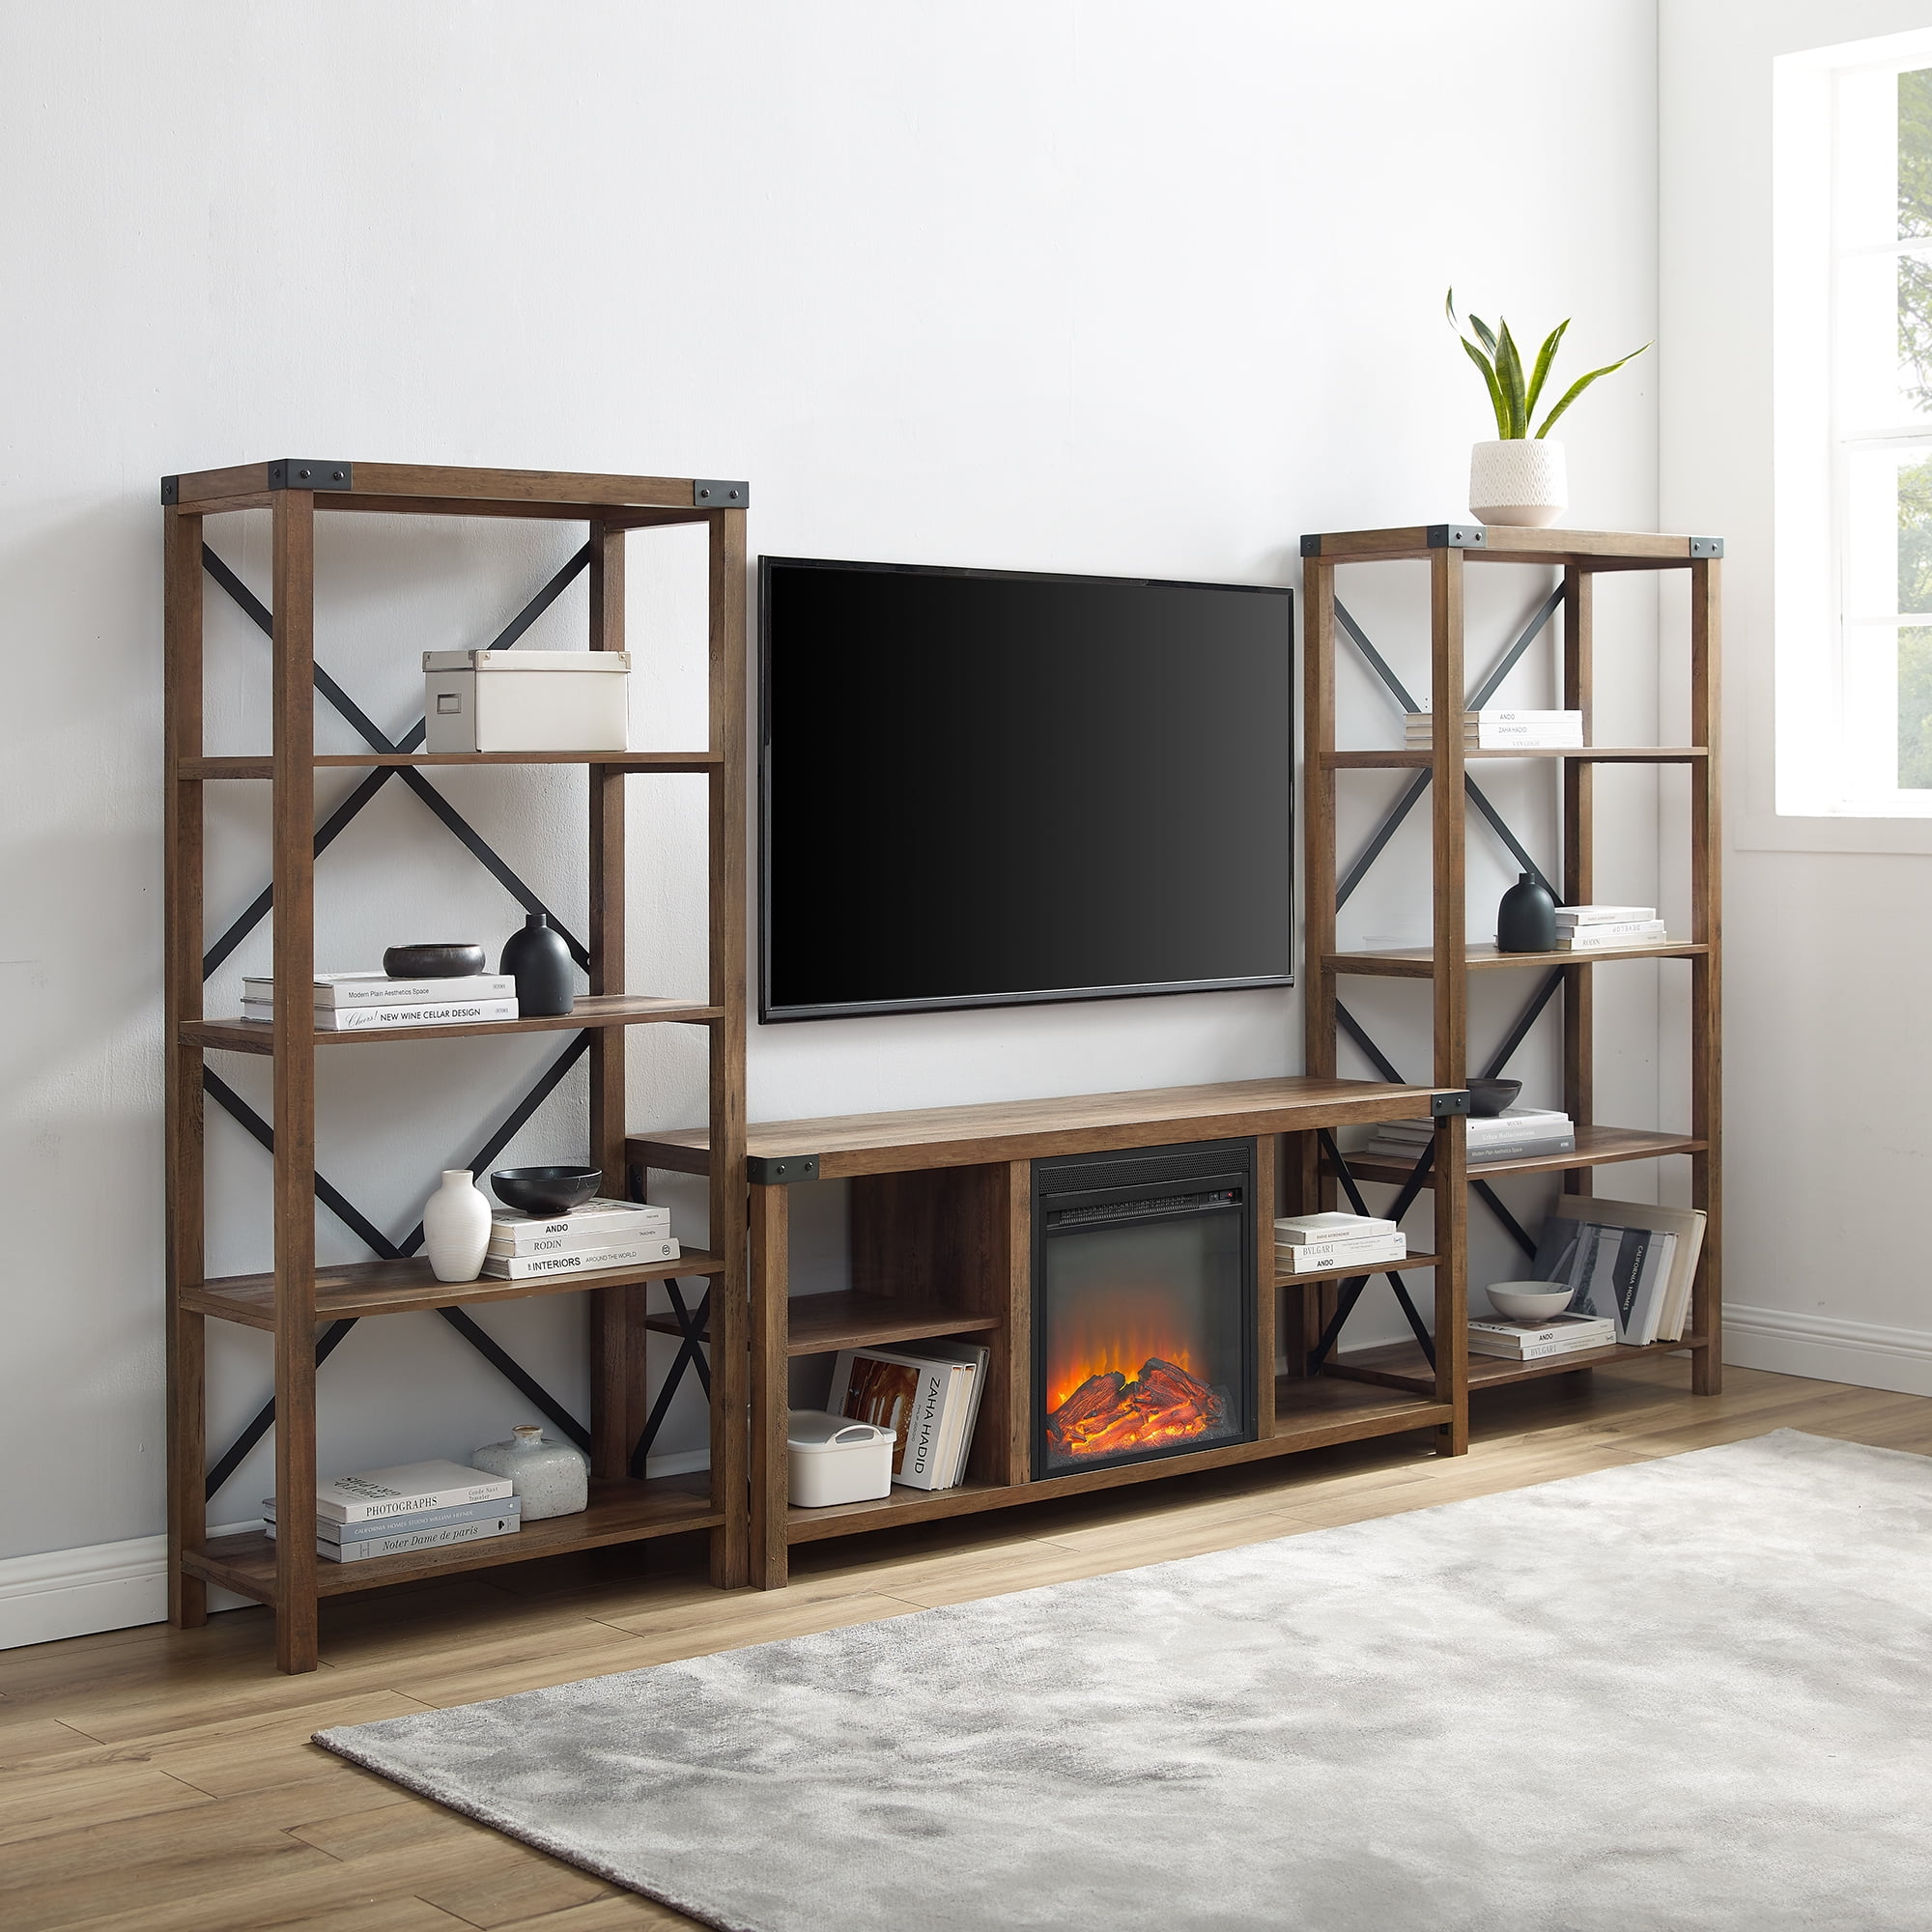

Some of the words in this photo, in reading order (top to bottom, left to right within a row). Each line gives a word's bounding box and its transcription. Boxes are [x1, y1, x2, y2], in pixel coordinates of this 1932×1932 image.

[348, 990, 369, 999] Modern
[384, 988, 412, 997] Aesthetics
[412, 987, 430, 996] Space
[380, 1012, 400, 1022] NEW
[401, 1011, 421, 1020] WINE
[423, 1009, 450, 1019] CELLAR
[451, 1009, 481, 1017] DESIGN
[545, 1223, 569, 1234] ANDO
[533, 1239, 563, 1251] RODIN
[532, 1257, 582, 1271] INTERIORS
[617, 1251, 637, 1260] WORLD
[1317, 1259, 1334, 1267] ANDO
[1629, 1245, 1644, 1284] CALIFORNIA
[1623, 1286, 1634, 1311] HOMES
[1539, 1333, 1553, 1342] ANDO
[924, 1377, 941, 1420] ZAHA
[915, 1424, 932, 1474] HADID
[365, 1496, 438, 1517] PHOTOGRAPHS
[355, 1524, 386, 1535] CALIFORNIA
[386, 1521, 408, 1530] HOMES
[408, 1518, 428, 1527] STUDIO
[429, 1514, 453, 1523] WILLIAM
[383, 1535, 410, 1551] Noter
[411, 1533, 438, 1546] Dame
[440, 1530, 451, 1541] de
[453, 1524, 479, 1540] paris
